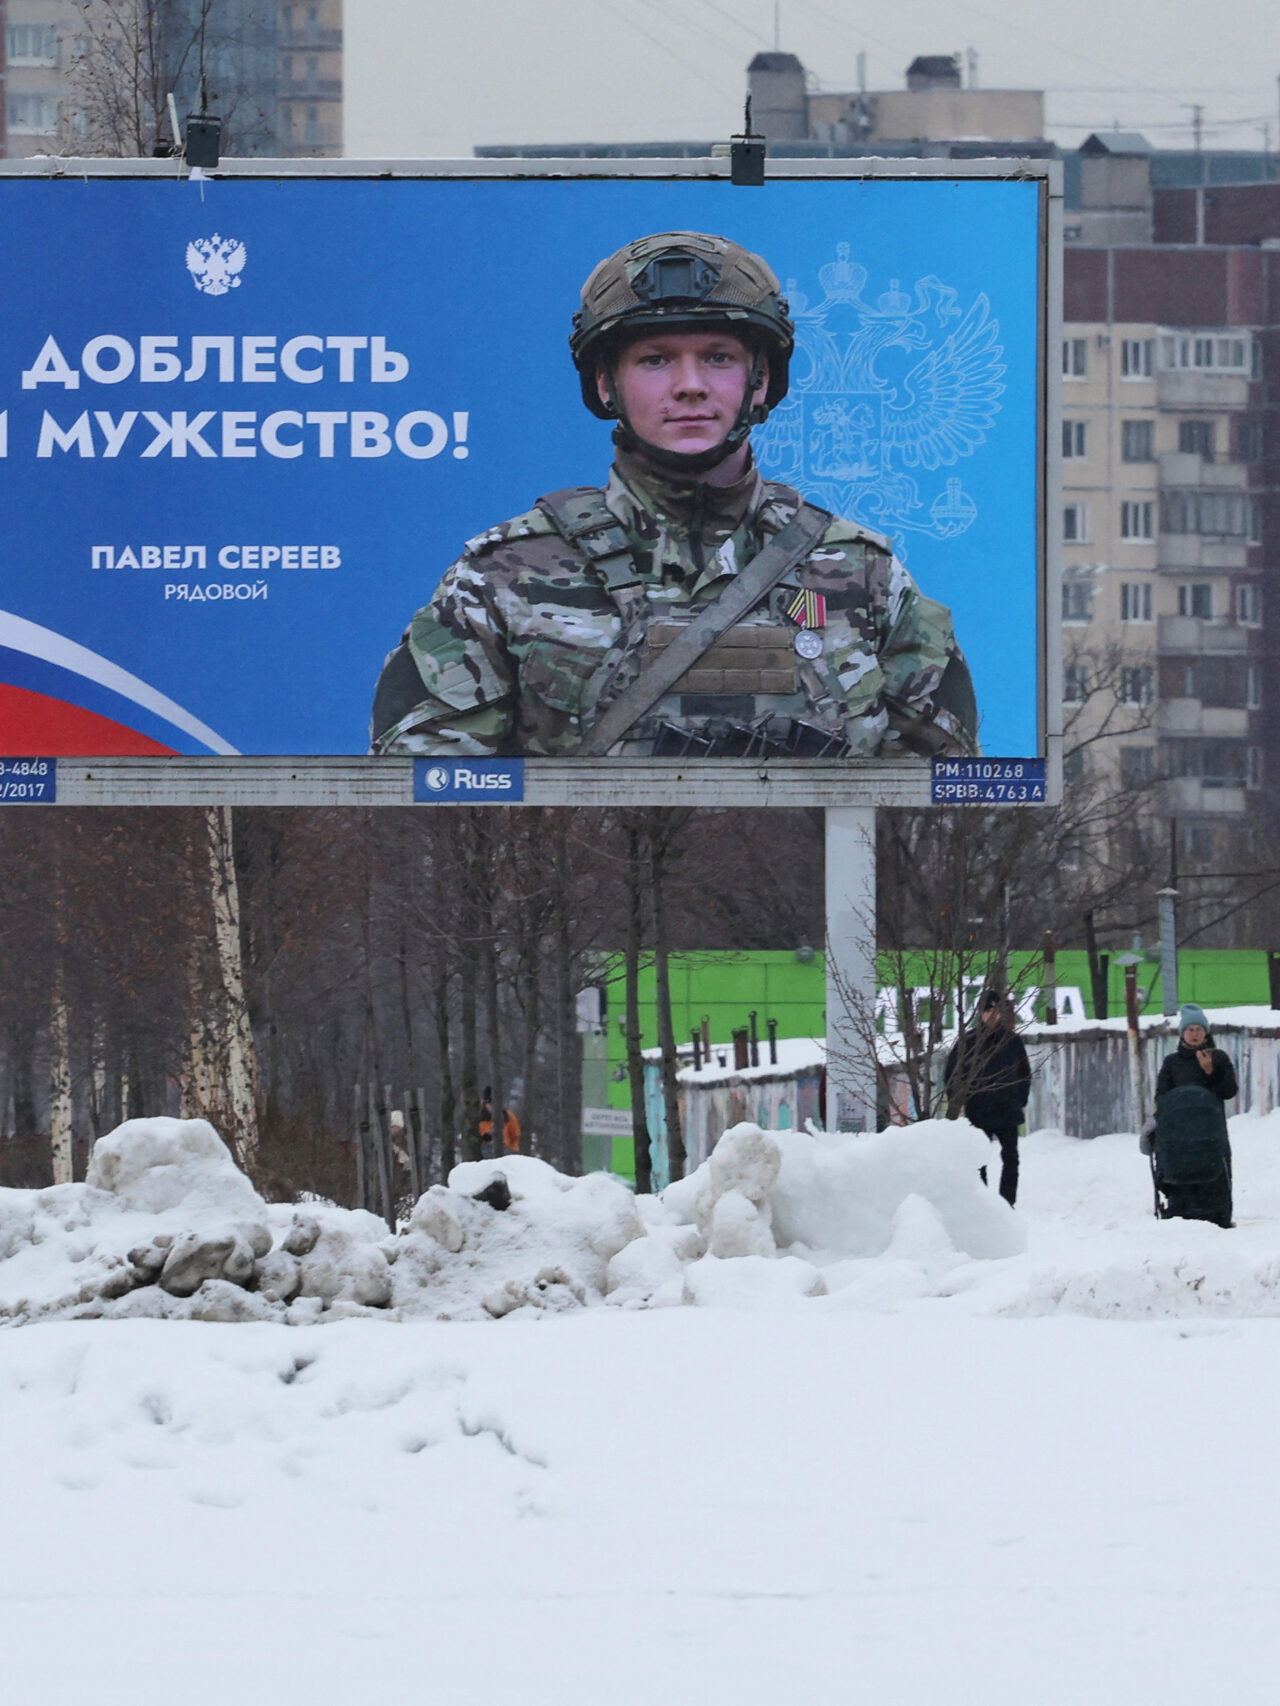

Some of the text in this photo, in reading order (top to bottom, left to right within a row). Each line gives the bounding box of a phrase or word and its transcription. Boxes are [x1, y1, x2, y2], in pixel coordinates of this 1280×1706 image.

[22, 335, 409, 389] ДОБЛЕСТЬ
[37, 410, 469, 459] МУЖЕСТВО!
[92, 546, 341, 569] ПАВЕЛ СЕРЕЕВ
[165, 580, 267, 601] РЯДОВОЙ
[455, 769, 511, 788] Russ
[936, 763, 1023, 778] PM:110268
